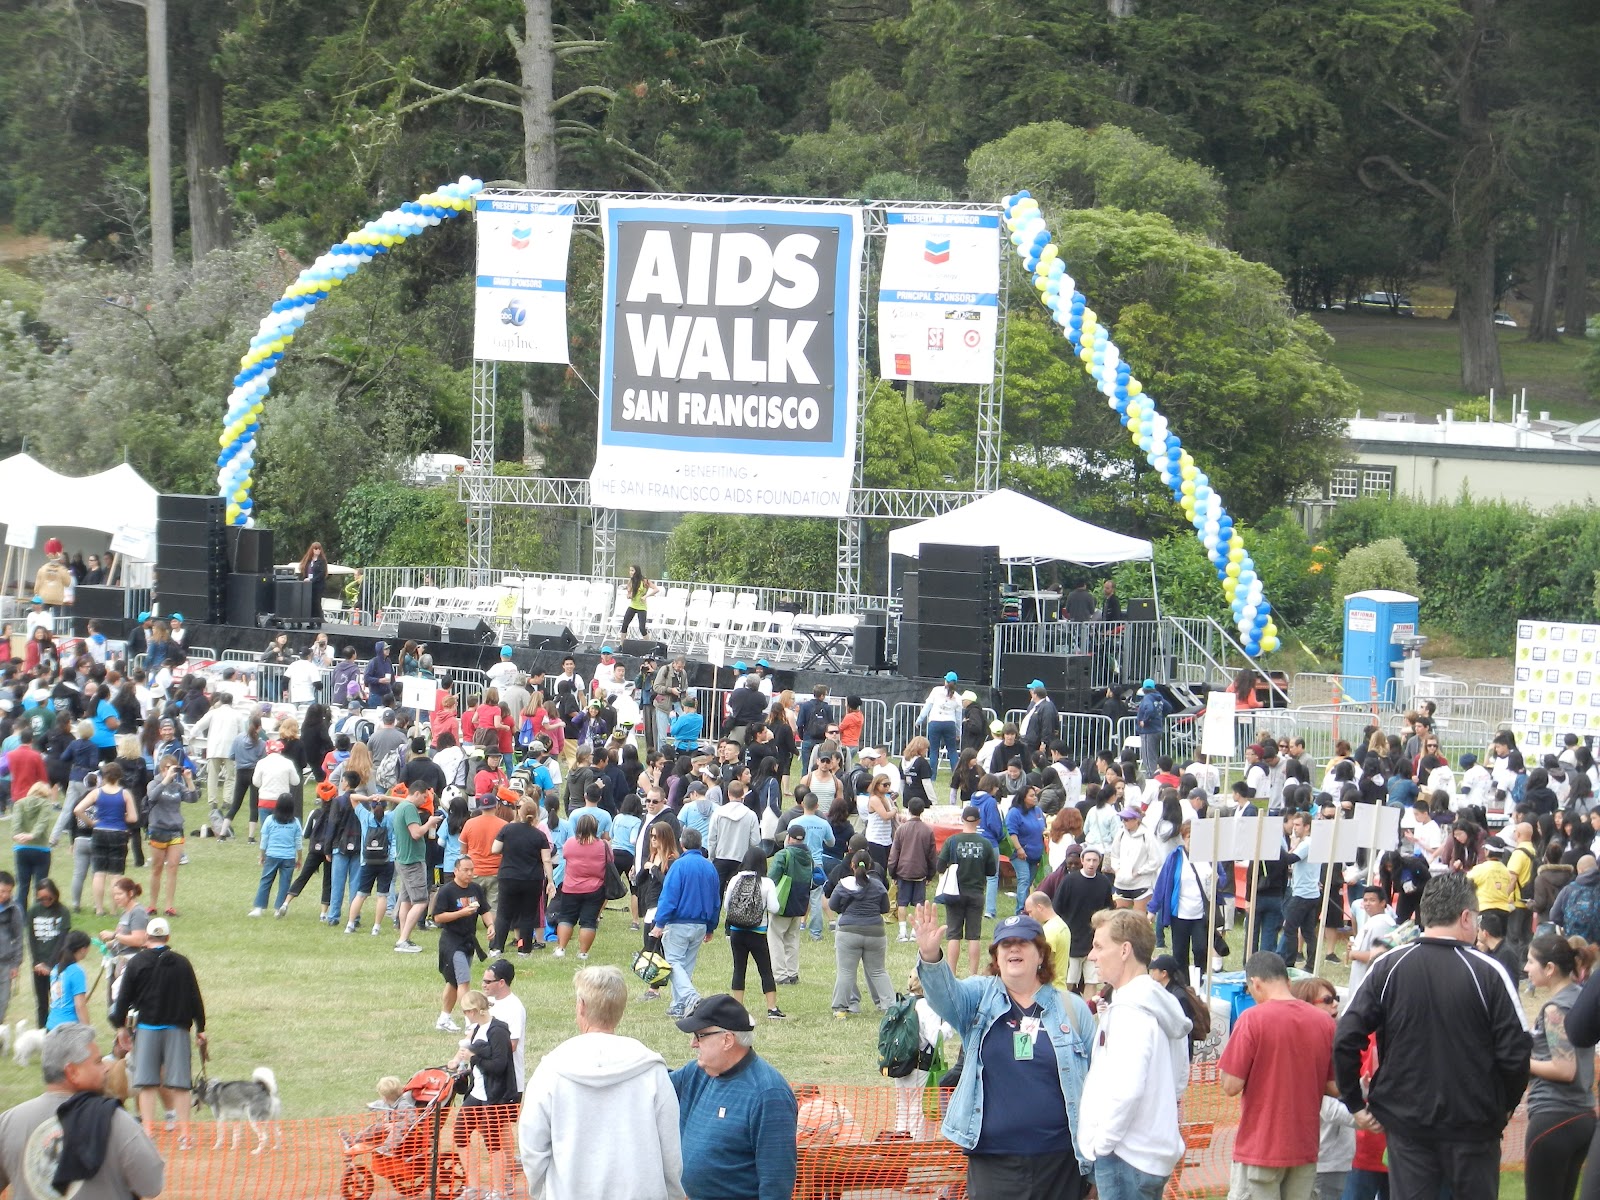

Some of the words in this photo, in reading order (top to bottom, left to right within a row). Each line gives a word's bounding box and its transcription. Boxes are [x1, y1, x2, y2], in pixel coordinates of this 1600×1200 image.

[903, 214, 944, 224] PRESENTING
[945, 214, 980, 225] SPONSOR
[626, 230, 820, 309] AIDS
[511, 278, 542, 289] SPONSORS
[896, 291, 932, 301] PRINCIPAL
[934, 292, 977, 303] SPONSORS
[929, 328, 944, 346] SF
[625, 313, 820, 385] WALK
[622, 388, 669, 423] SAN
[678, 392, 820, 430] FRANCISCO
[684, 464, 748, 480] BENEFITING
[620, 480, 644, 495] SAN
[648, 482, 719, 501] FRANCISCO
[724, 488, 752, 503] AIDS
[756, 489, 841, 506] FOUNDATION
[1193, 1036, 1216, 1049] Wet
